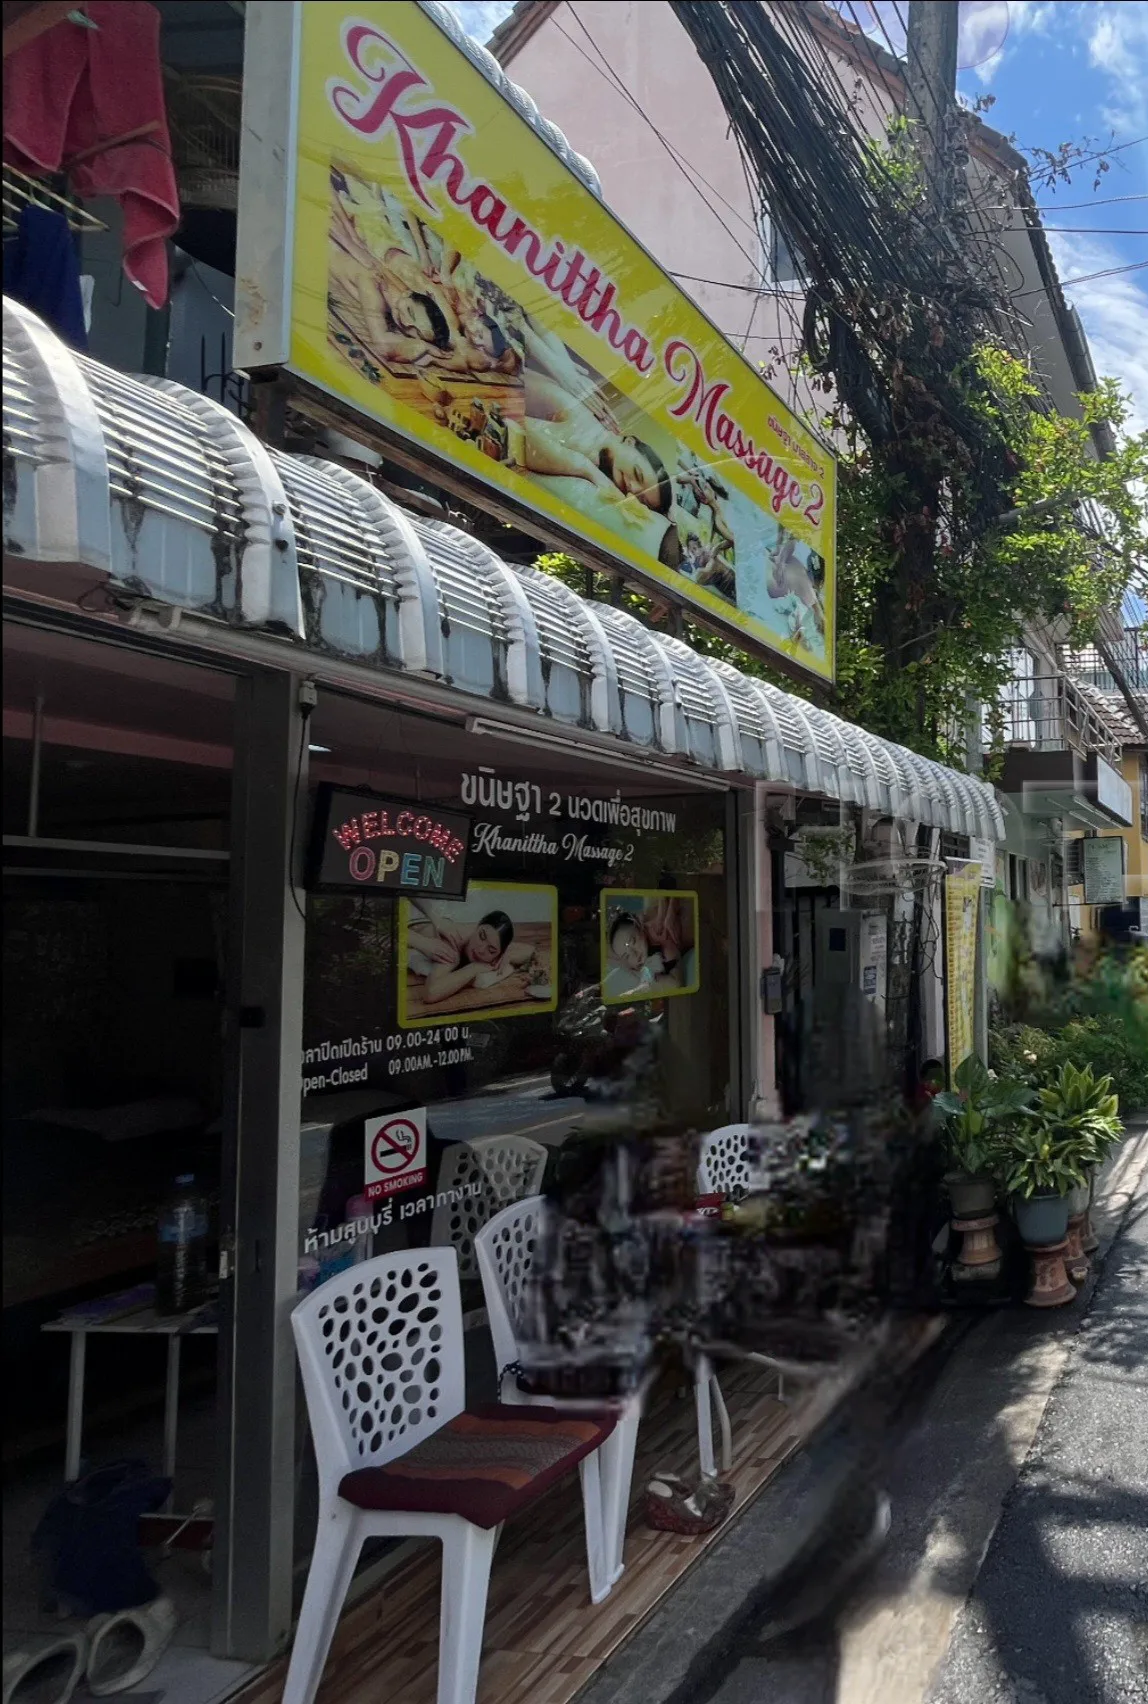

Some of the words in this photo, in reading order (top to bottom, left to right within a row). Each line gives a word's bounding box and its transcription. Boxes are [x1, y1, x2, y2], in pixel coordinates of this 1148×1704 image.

[332, 25, 655, 372] Khanittha
[664, 341, 803, 513] Massage
[804, 483, 824, 526] 2
[461, 766, 541, 821] ขนิษฐา
[549, 792, 562, 816] 2
[568, 789, 676, 837] นวดเพื่อสุขภาพ
[331, 810, 464, 864] WELCOME
[472, 822, 558, 858] Khanittha
[562, 833, 623, 868] Massage
[624, 843, 634, 862] 2
[350, 846, 446, 888] OPEN
[300, 1062, 368, 1097] pen-Closed
[368, 1186, 382, 1198] NO
[384, 1172, 424, 1191] SMOKING
[304, 1198, 393, 1254] ห้ามสูบบุรี่
